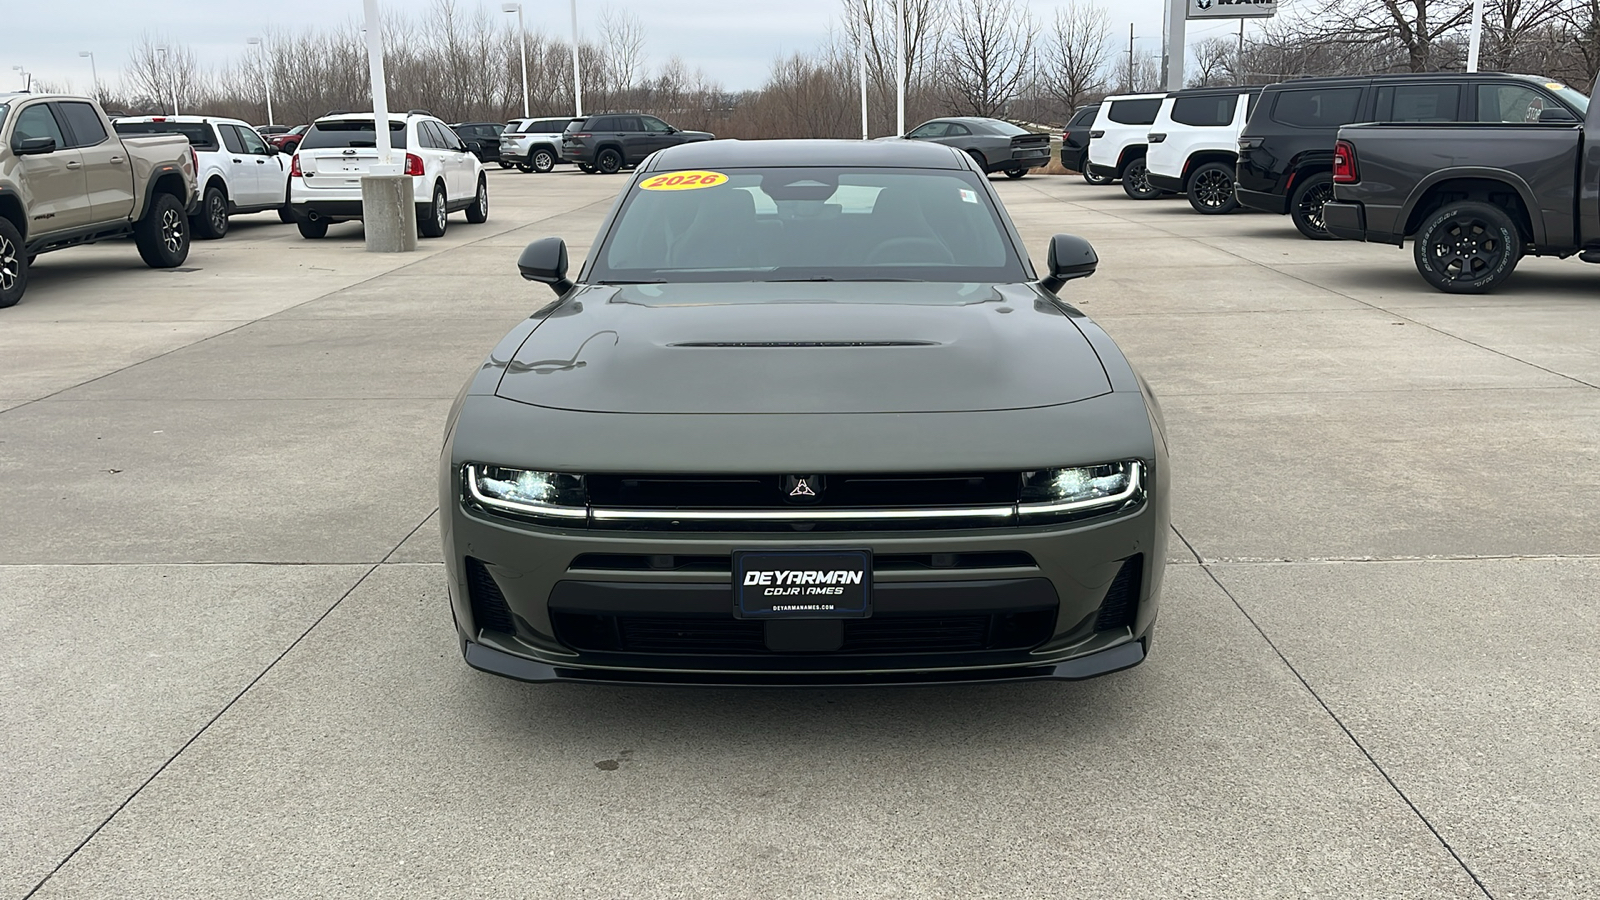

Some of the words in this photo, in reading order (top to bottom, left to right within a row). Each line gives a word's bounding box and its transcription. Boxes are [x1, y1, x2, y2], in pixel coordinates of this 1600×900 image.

[648, 174, 719, 187] 2026
[743, 570, 863, 586] DEYARMAN
[806, 587, 843, 595] AMES
